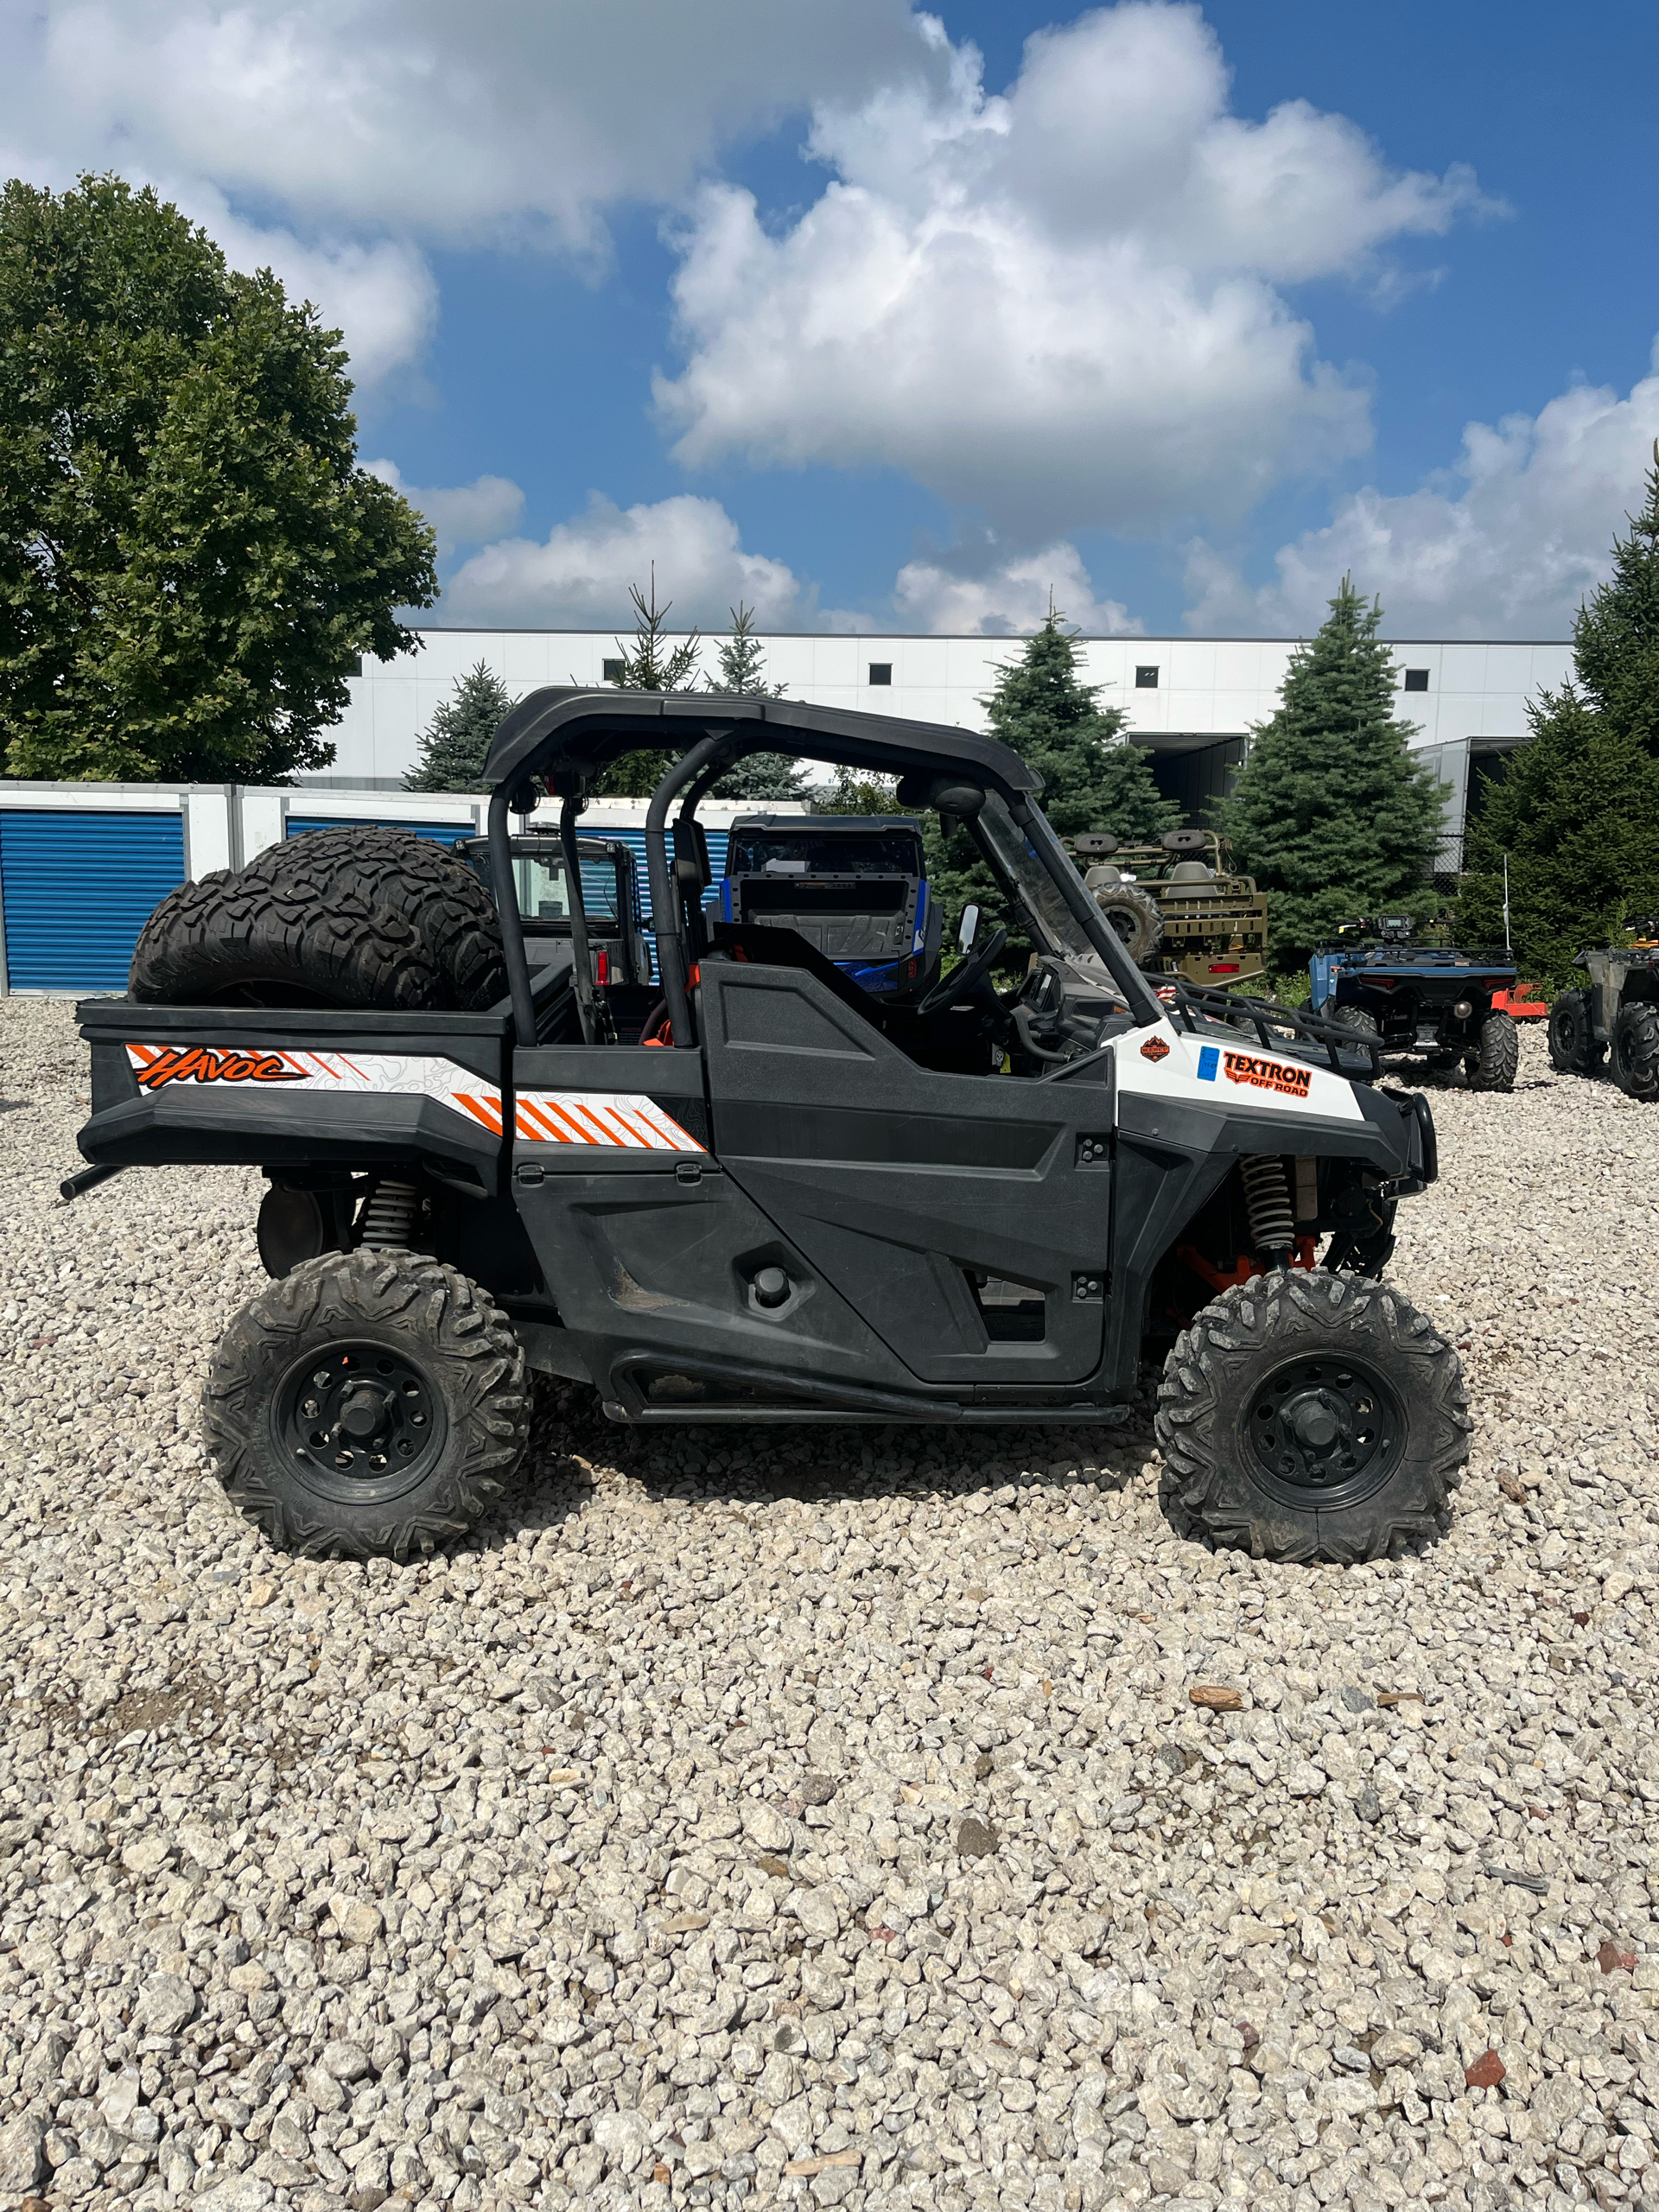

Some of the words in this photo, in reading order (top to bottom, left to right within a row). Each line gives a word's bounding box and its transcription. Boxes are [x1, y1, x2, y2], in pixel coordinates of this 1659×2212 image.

[137, 1046, 314, 1089] HAVOC
[1225, 1052, 1311, 1088] TEXTRON
[1250, 1077, 1273, 1088] OFF
[1274, 1083, 1308, 1096] ROAD
